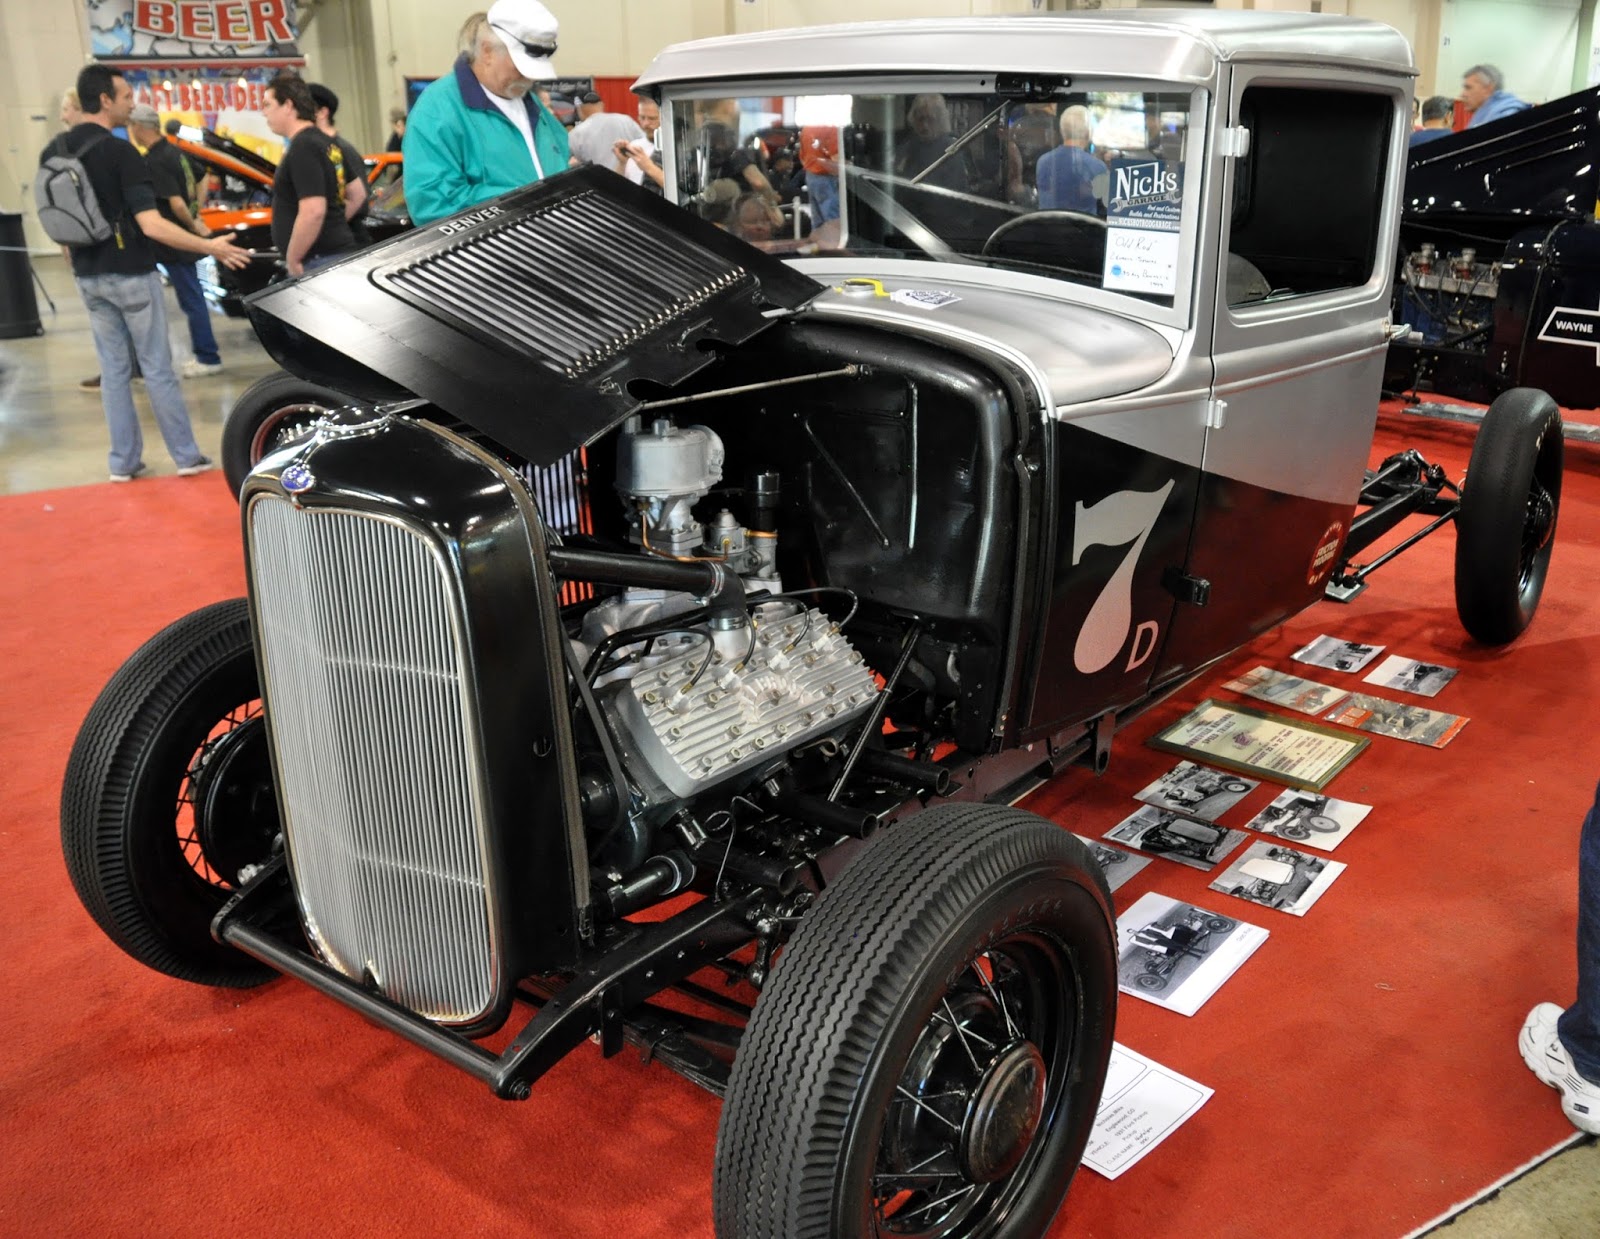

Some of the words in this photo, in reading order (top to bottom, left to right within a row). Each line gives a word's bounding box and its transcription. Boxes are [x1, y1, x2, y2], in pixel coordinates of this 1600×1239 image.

[133, 0, 294, 43] BEER
[178, 82, 226, 112] BEER
[1127, 195, 1166, 206] GARAGE
[438, 206, 505, 236] DENVER
[1555, 320, 1593, 333] WAYNE
[1072, 478, 1176, 674] 7
[1124, 620, 1159, 674] D
